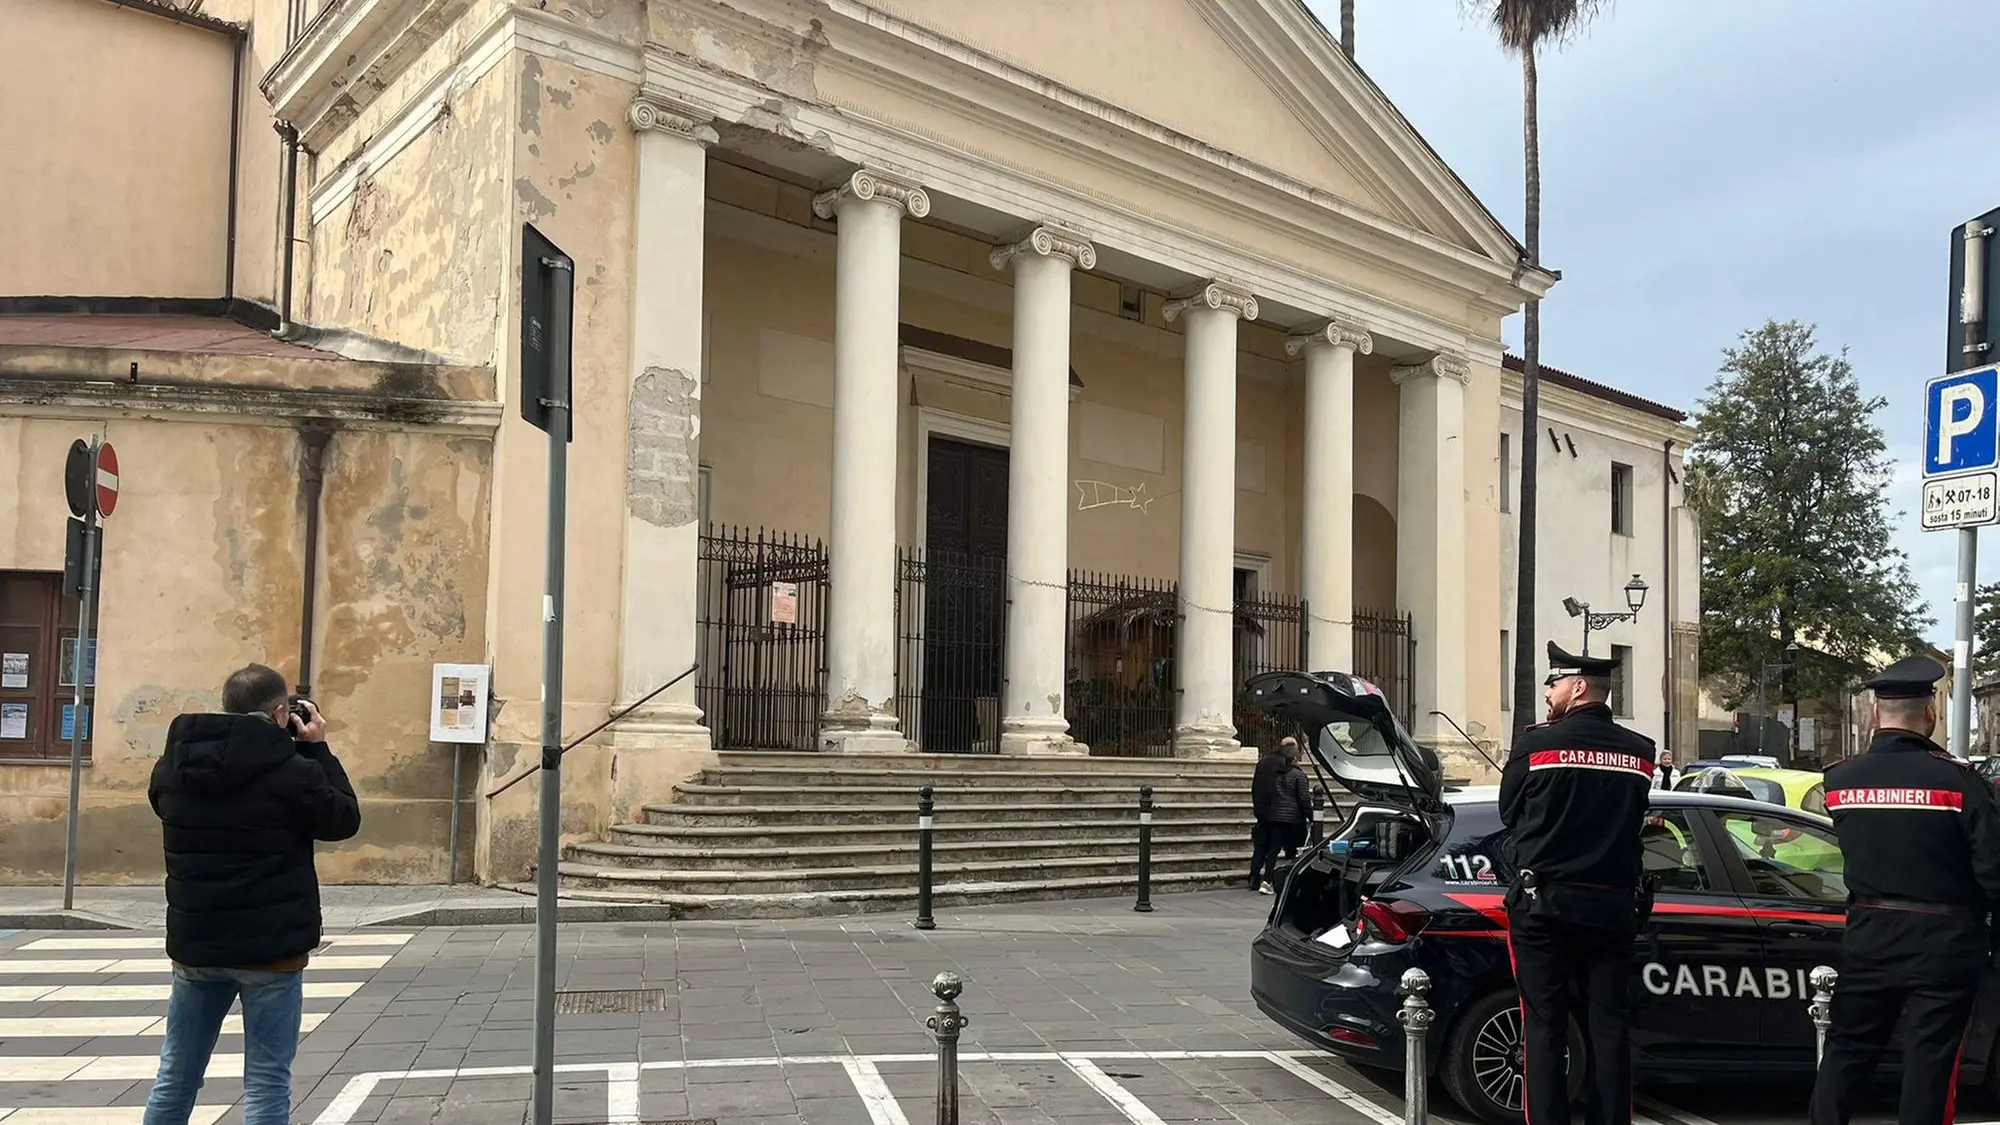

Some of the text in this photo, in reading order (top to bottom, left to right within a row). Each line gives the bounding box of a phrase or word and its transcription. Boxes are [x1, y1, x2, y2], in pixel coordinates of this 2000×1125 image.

[1938, 383, 1984, 464] P
[1958, 487, 1990, 503] 07-18
[1930, 507, 1988, 523] sosta 15 minuti
[1559, 750, 1641, 770] CARABINIERI
[1838, 788, 1931, 805] CARABINIERI
[1439, 854, 1497, 880] 112
[1642, 962, 1807, 1000] CARABI
